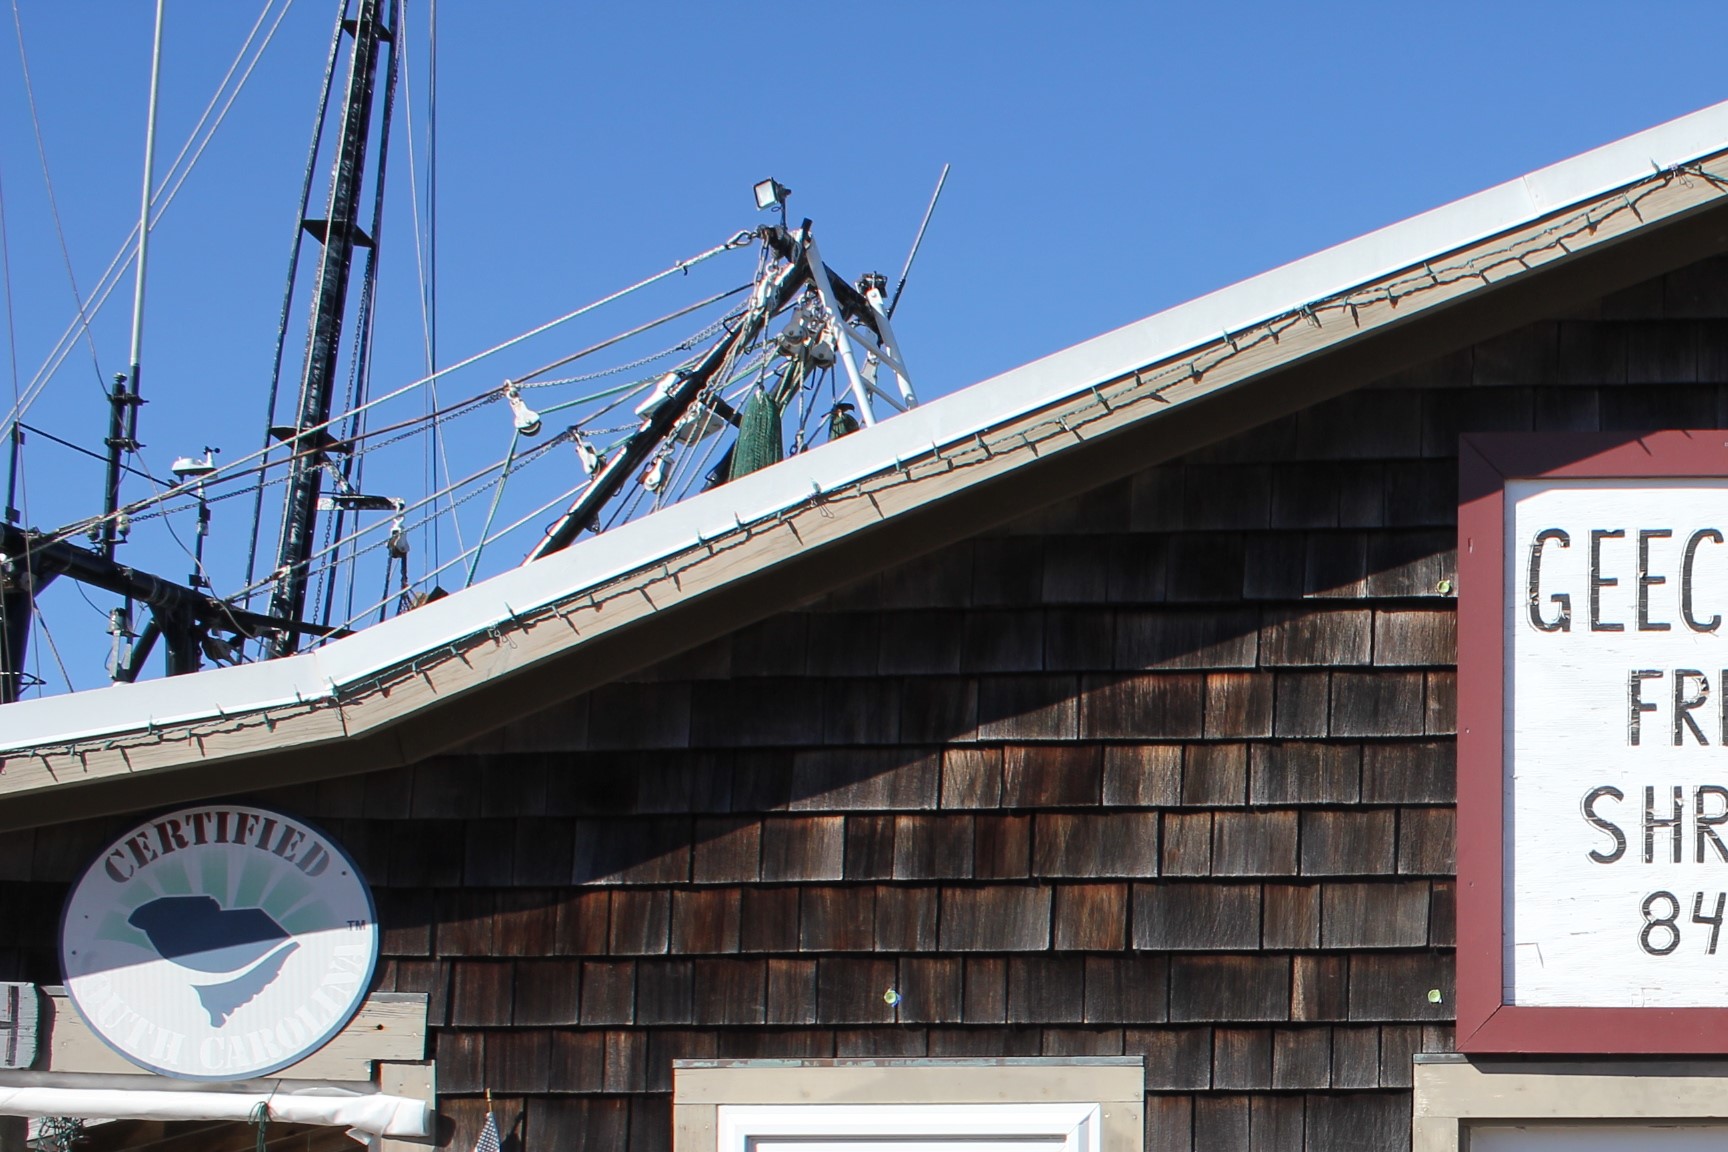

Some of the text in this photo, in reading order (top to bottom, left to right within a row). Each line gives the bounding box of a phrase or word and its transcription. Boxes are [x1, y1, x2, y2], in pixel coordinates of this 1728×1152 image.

[104, 810, 331, 884] CERTIFIED
[347, 920, 366, 931] TM
[76, 951, 187, 1066] OUTH
[199, 942, 366, 1069] CAROLINA
